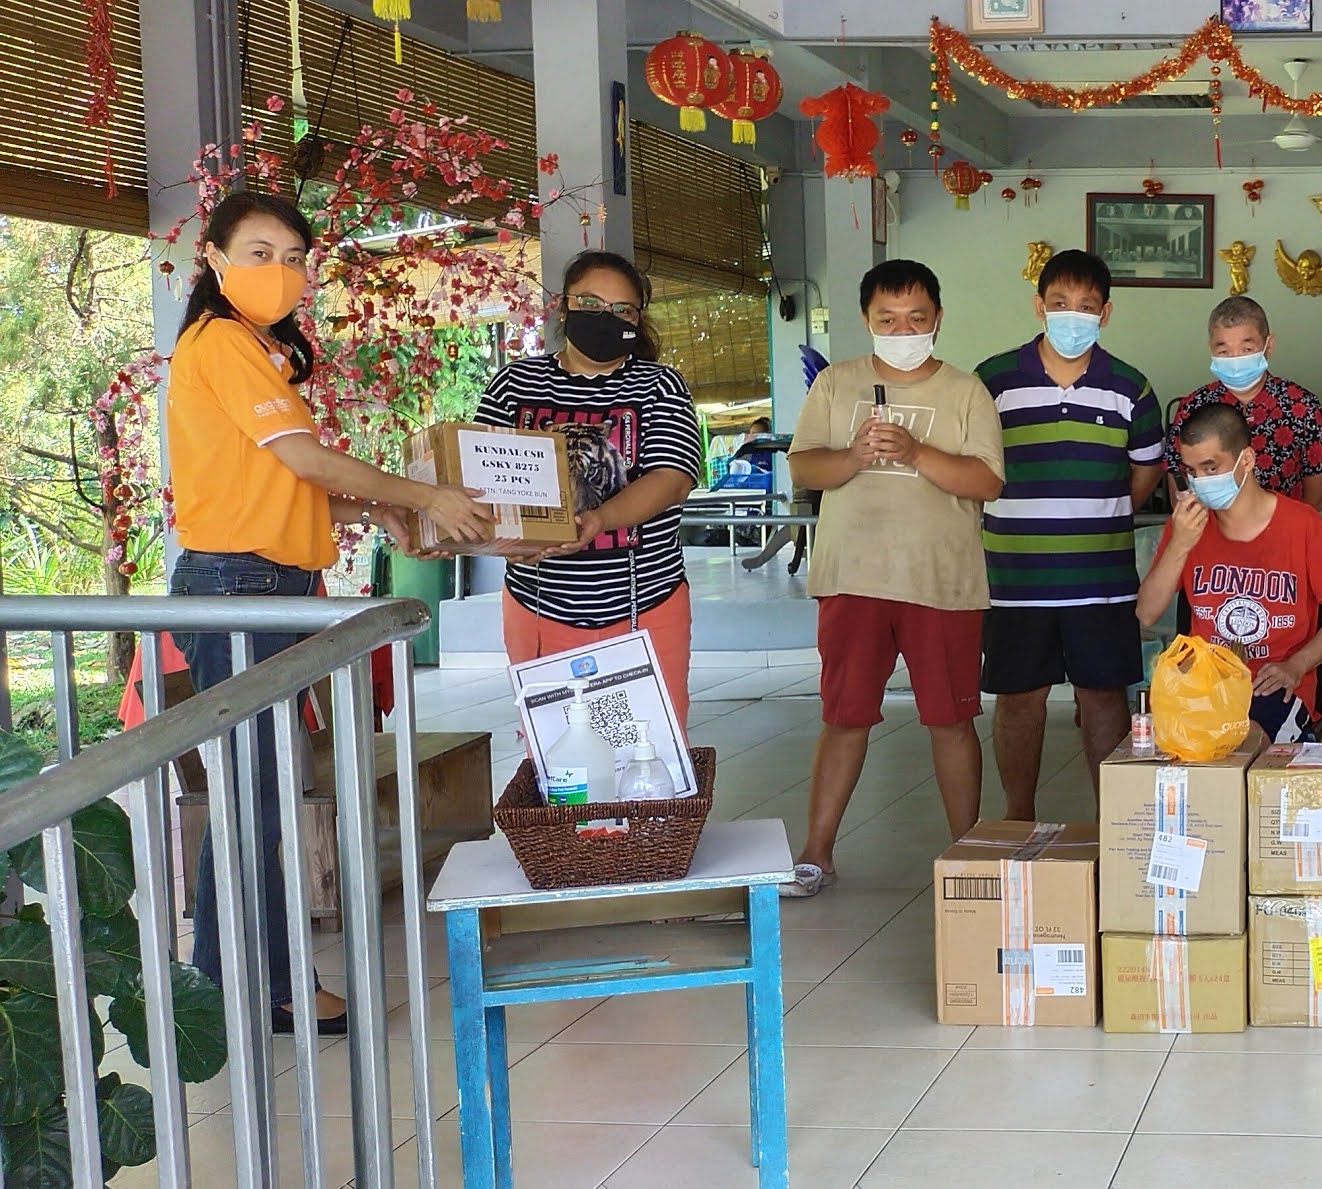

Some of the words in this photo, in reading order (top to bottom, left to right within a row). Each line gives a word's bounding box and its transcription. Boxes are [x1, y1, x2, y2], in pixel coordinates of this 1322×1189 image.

[474, 445, 521, 457] KUNDAL
[523, 449, 545, 459] CSR
[482, 459, 512, 470] GSKY
[515, 463, 540, 472] 8275
[494, 474, 507, 483] 25
[511, 475, 531, 485] PCS
[499, 488, 516, 496] TANG
[1193, 564, 1298, 605] LONDON
[1271, 615, 1296, 629] 1859
[530, 695, 547, 704] SCAN
[547, 691, 561, 700] WITH
[602, 677, 614, 685] APP
[622, 667, 649, 678] CHECK-IN
[1158, 834, 1173, 843] 482
[1070, 986, 1085, 994] 482
